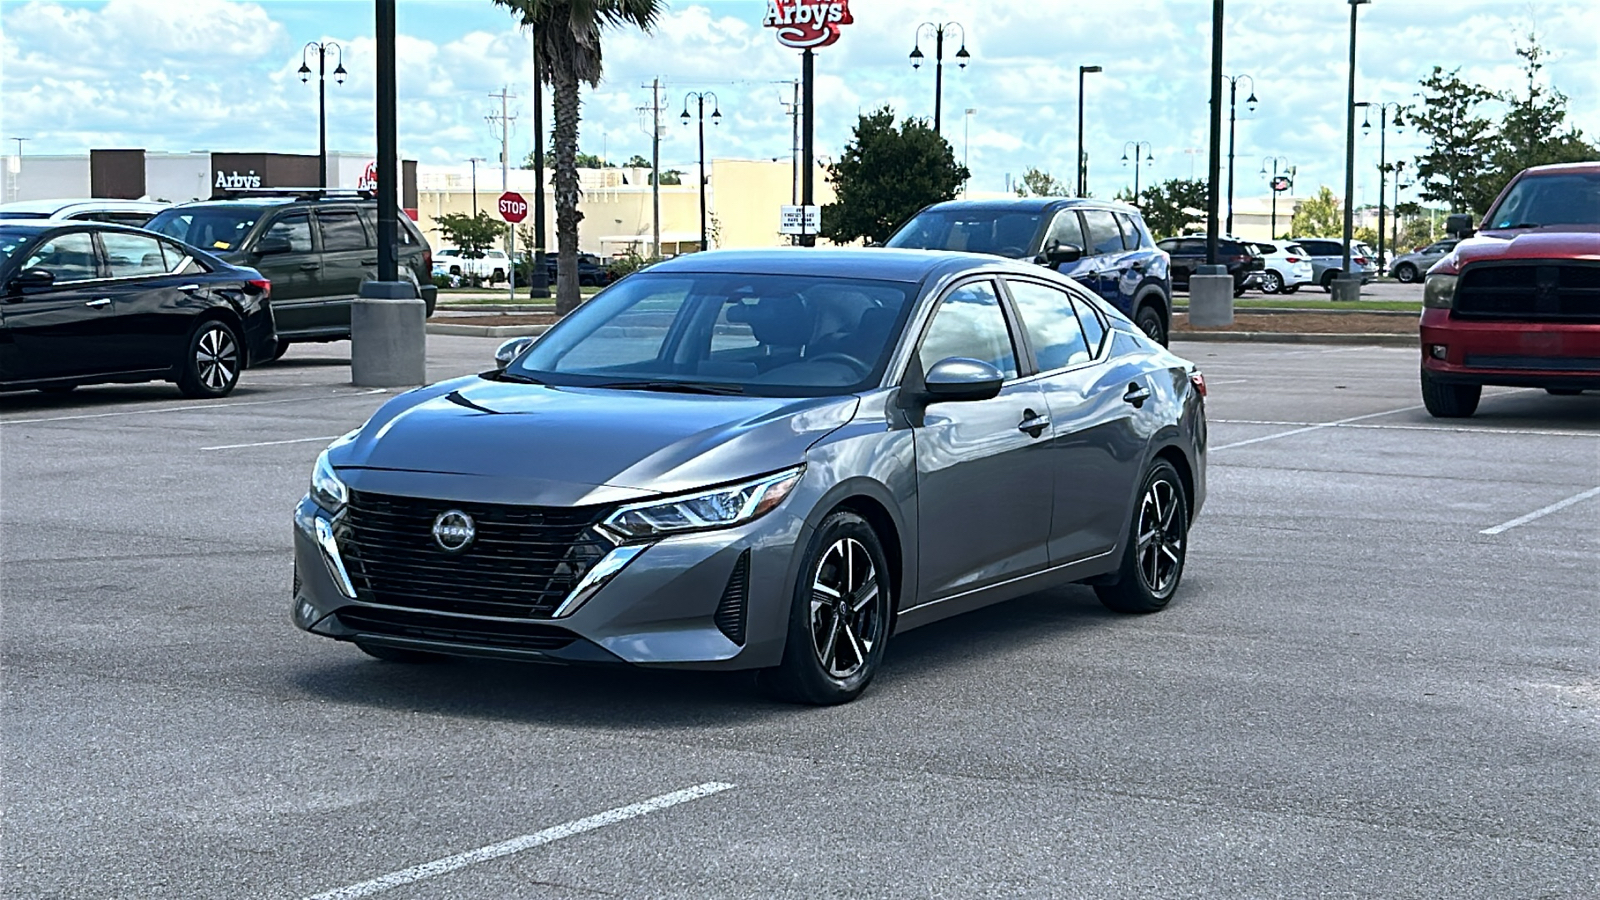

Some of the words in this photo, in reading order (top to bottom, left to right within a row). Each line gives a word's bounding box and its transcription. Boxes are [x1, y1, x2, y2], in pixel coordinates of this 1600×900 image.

[763, 0, 843, 31] Arbys
[215, 170, 261, 192] Arby's
[358, 176, 378, 192] Arb
[500, 199, 527, 215] STOP
[433, 525, 475, 537] NISSAN
